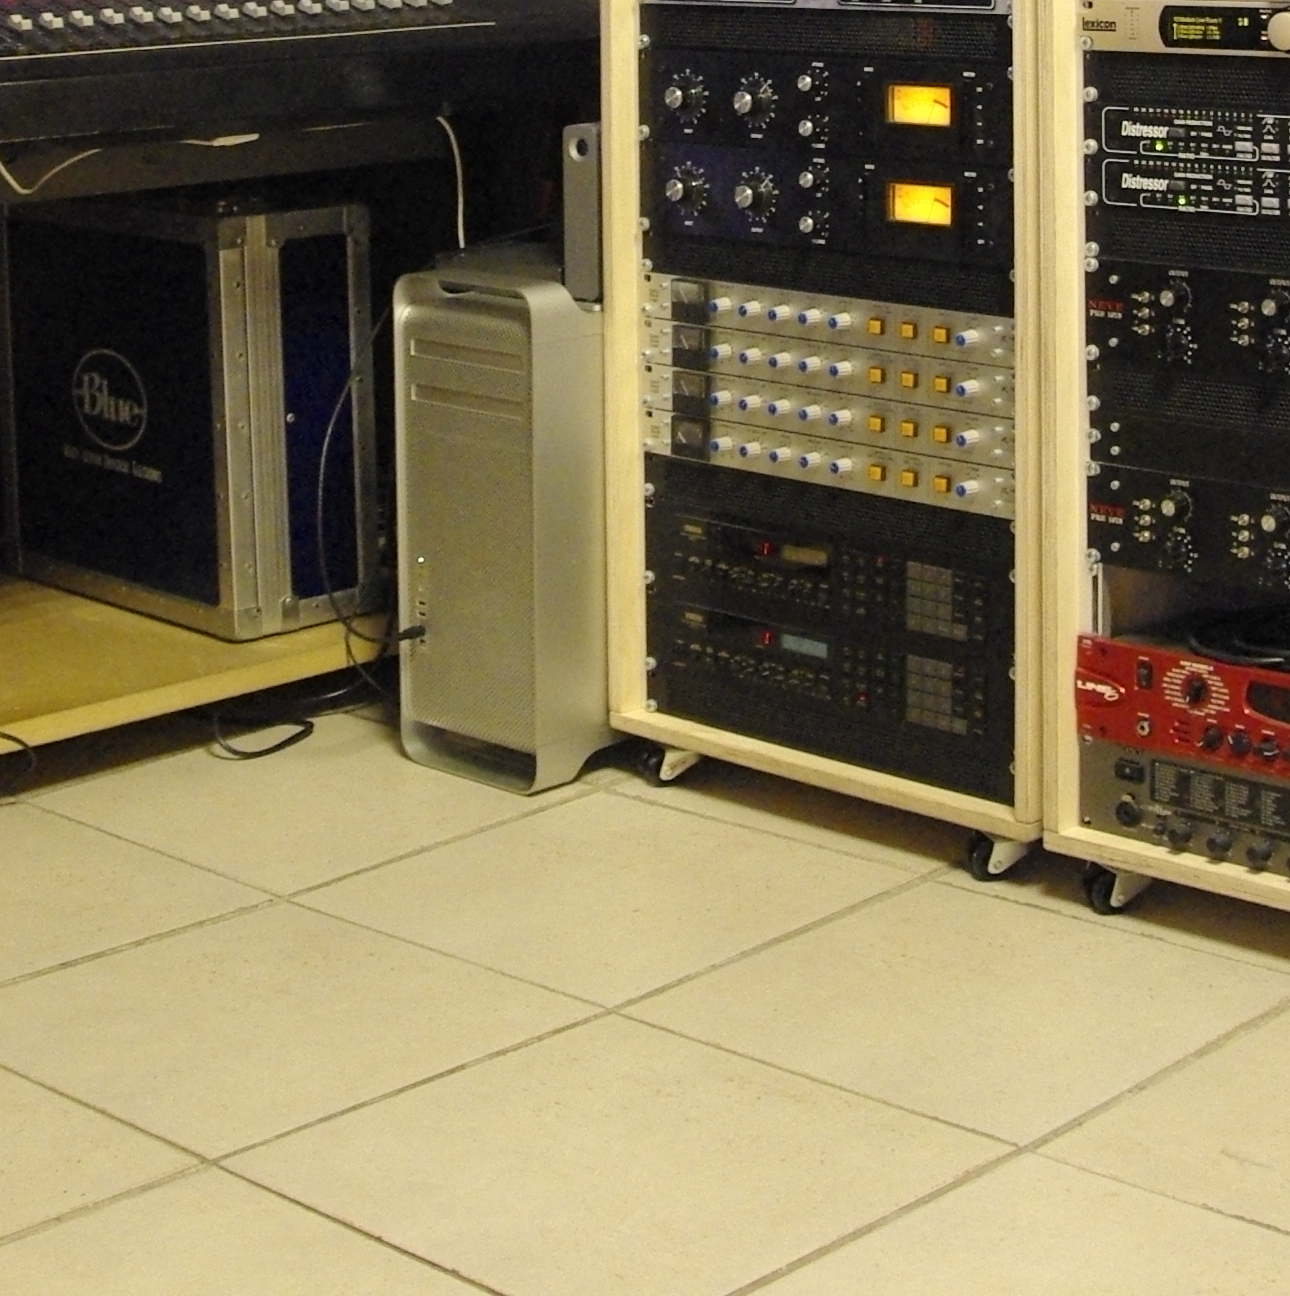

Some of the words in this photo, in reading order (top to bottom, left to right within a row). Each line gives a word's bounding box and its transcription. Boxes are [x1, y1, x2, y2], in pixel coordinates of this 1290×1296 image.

[1082, 17, 1117, 32] lexicon
[1121, 120, 1169, 138] Distressor
[1121, 172, 1170, 190] Distressor
[73, 372, 146, 427] Blue
